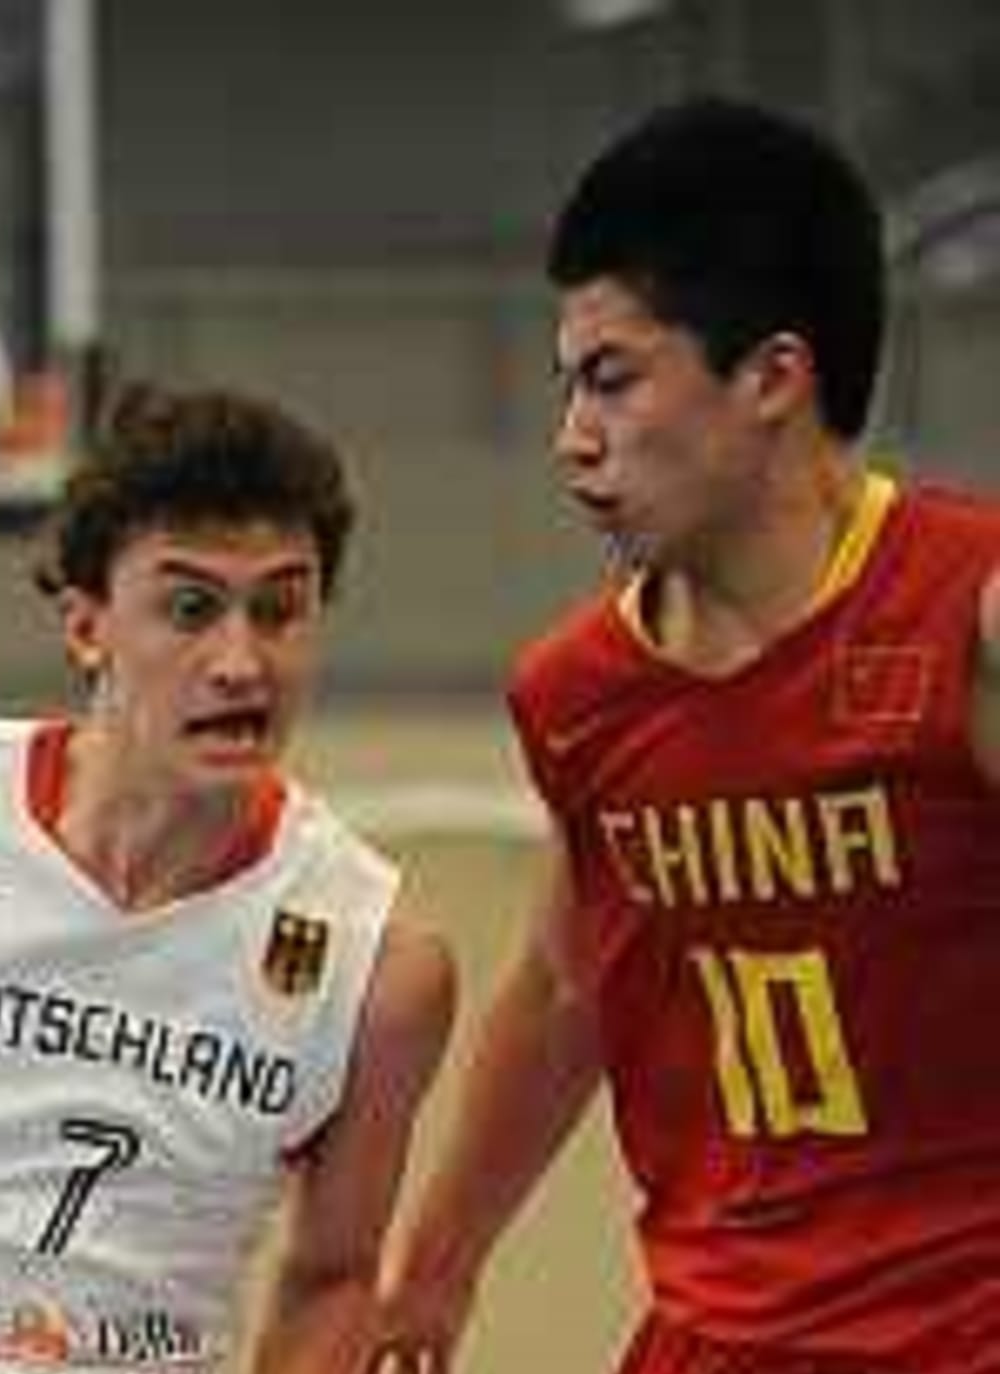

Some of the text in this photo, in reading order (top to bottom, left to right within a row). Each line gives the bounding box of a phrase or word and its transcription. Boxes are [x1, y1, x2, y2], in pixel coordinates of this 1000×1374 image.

[600, 786, 900, 906] CHINA
[690, 948, 868, 1136] 10
[37, 1119, 140, 1255] 7
